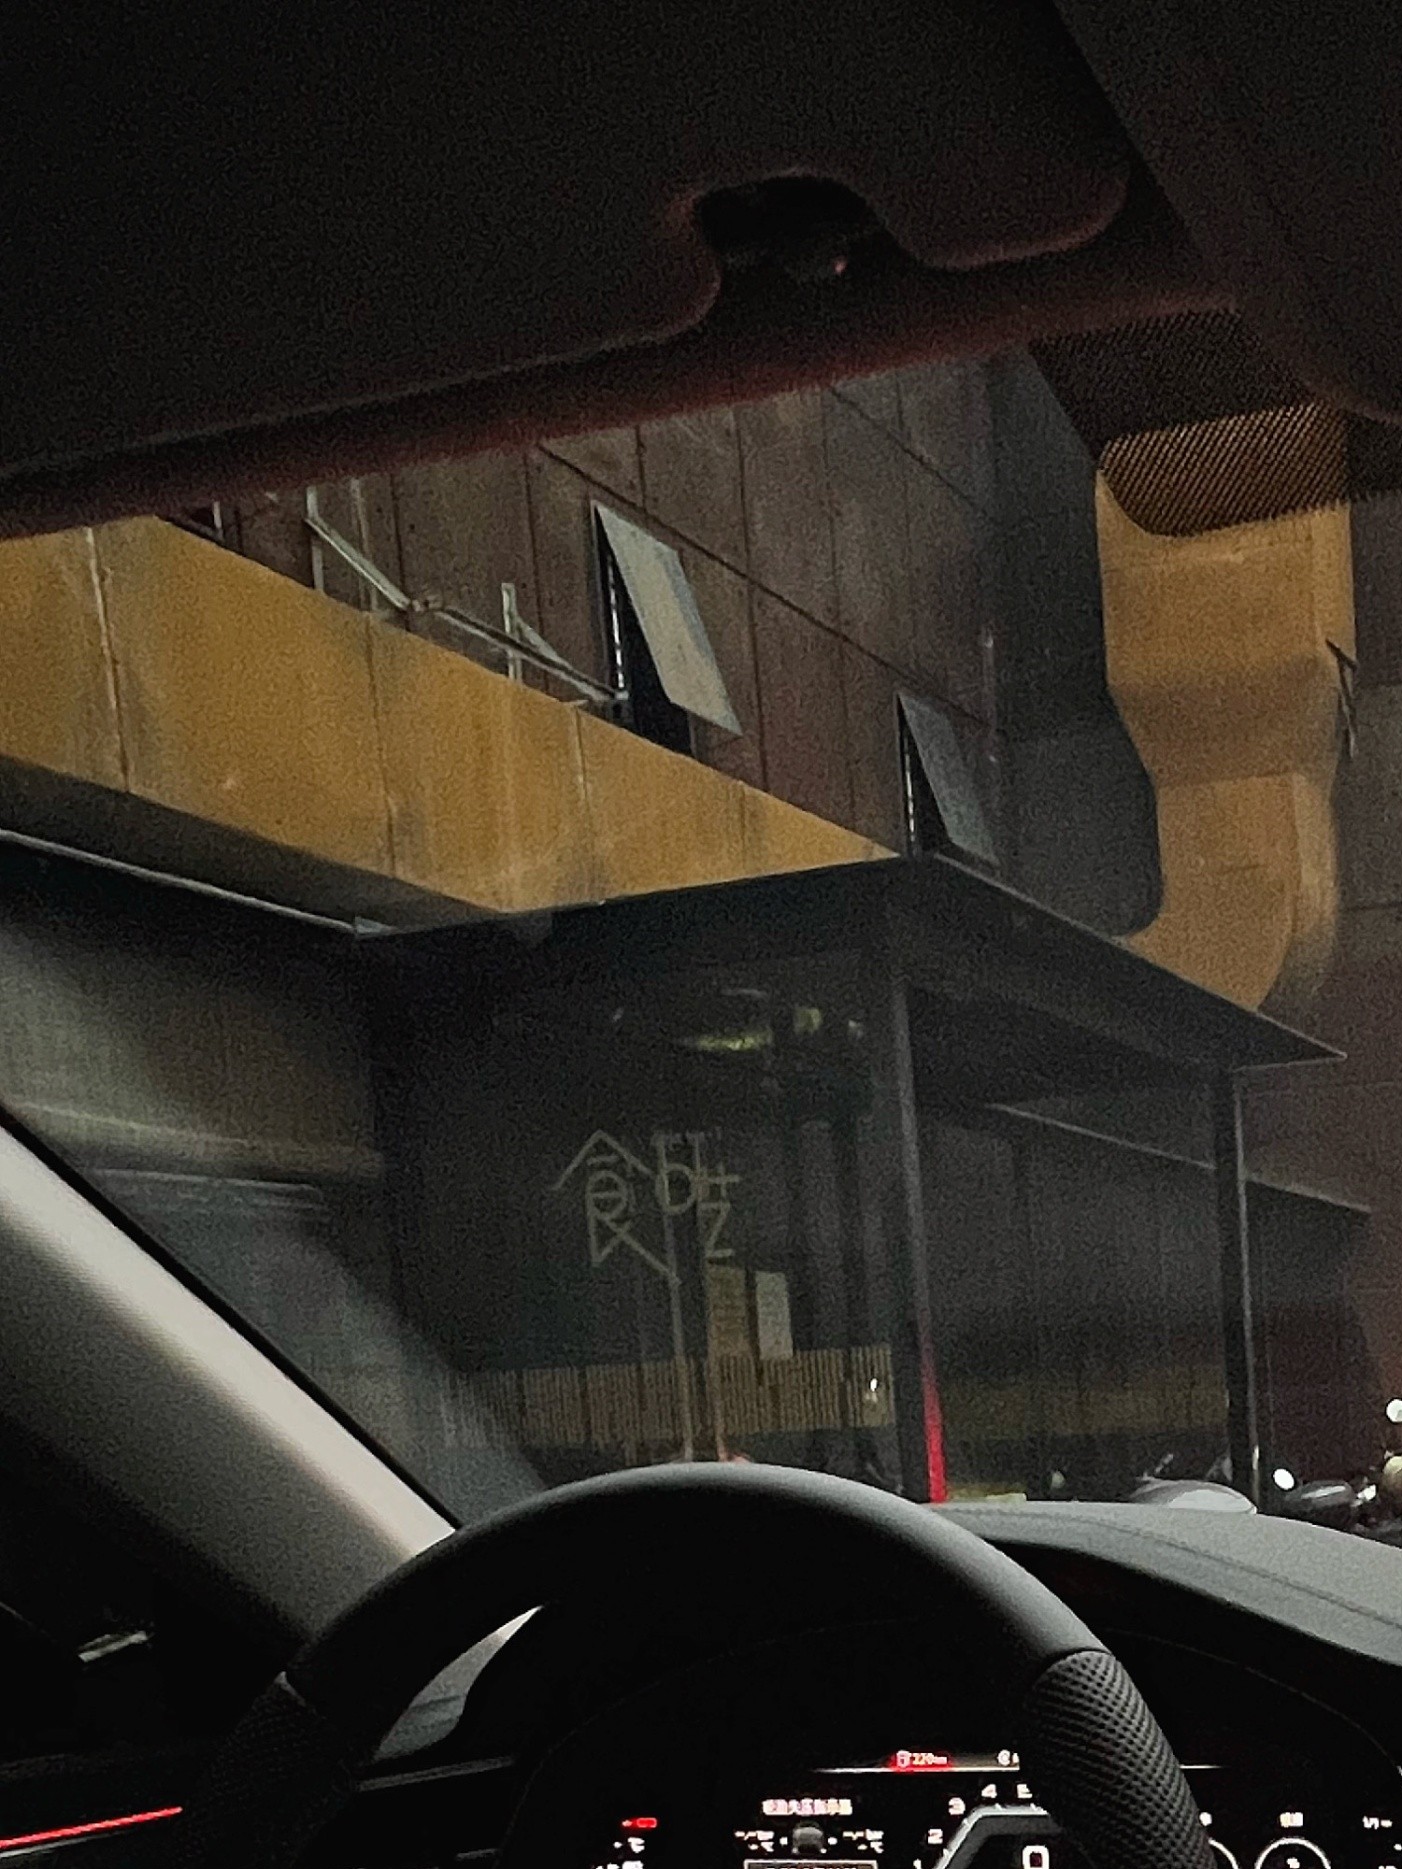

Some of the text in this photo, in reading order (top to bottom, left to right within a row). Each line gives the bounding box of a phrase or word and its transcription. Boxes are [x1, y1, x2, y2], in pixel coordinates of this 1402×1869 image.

[982, 1783, 998, 1799] 4
[948, 1797, 966, 1815] 3
[927, 1828, 943, 1845] 2
